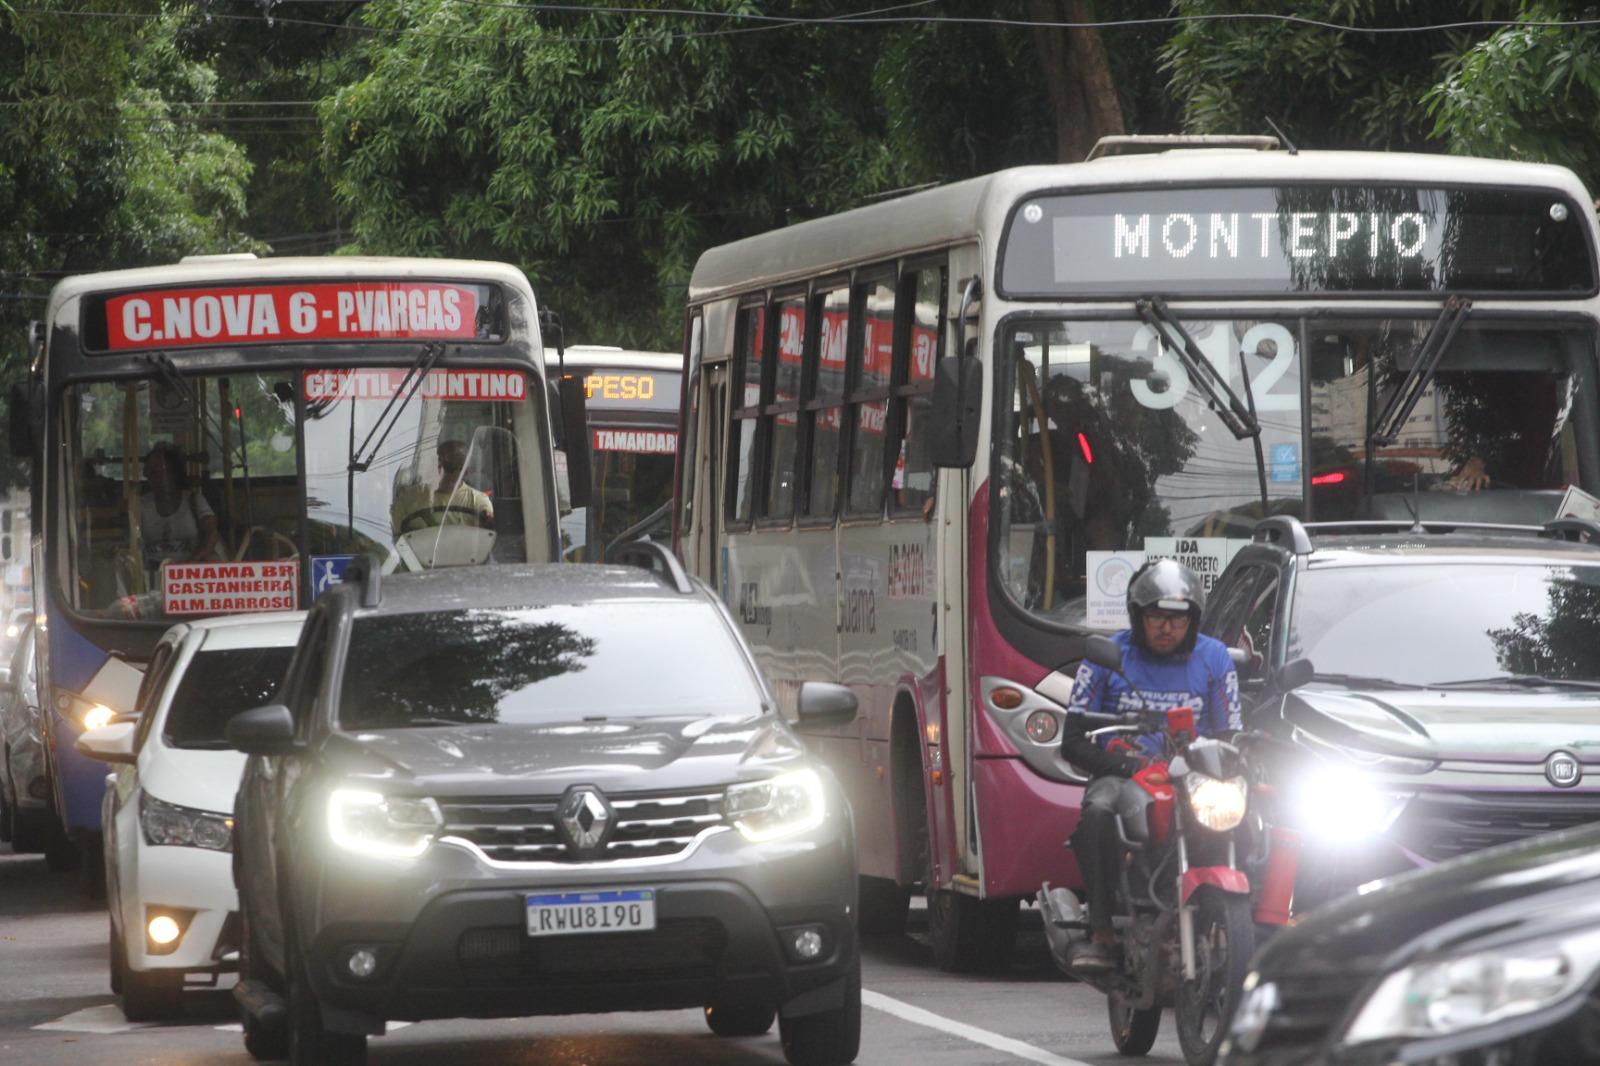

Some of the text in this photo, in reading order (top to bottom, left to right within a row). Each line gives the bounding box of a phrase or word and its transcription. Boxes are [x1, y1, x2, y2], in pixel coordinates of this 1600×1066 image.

[1114, 213, 1426, 258] MONTEPIO
[1130, 322, 1302, 410] 312
[597, 431, 679, 452] TAMANDAR
[1175, 540, 1199, 553] IDA
[168, 566, 255, 580] UNAMA
[168, 580, 293, 595] CASTANHEIRA
